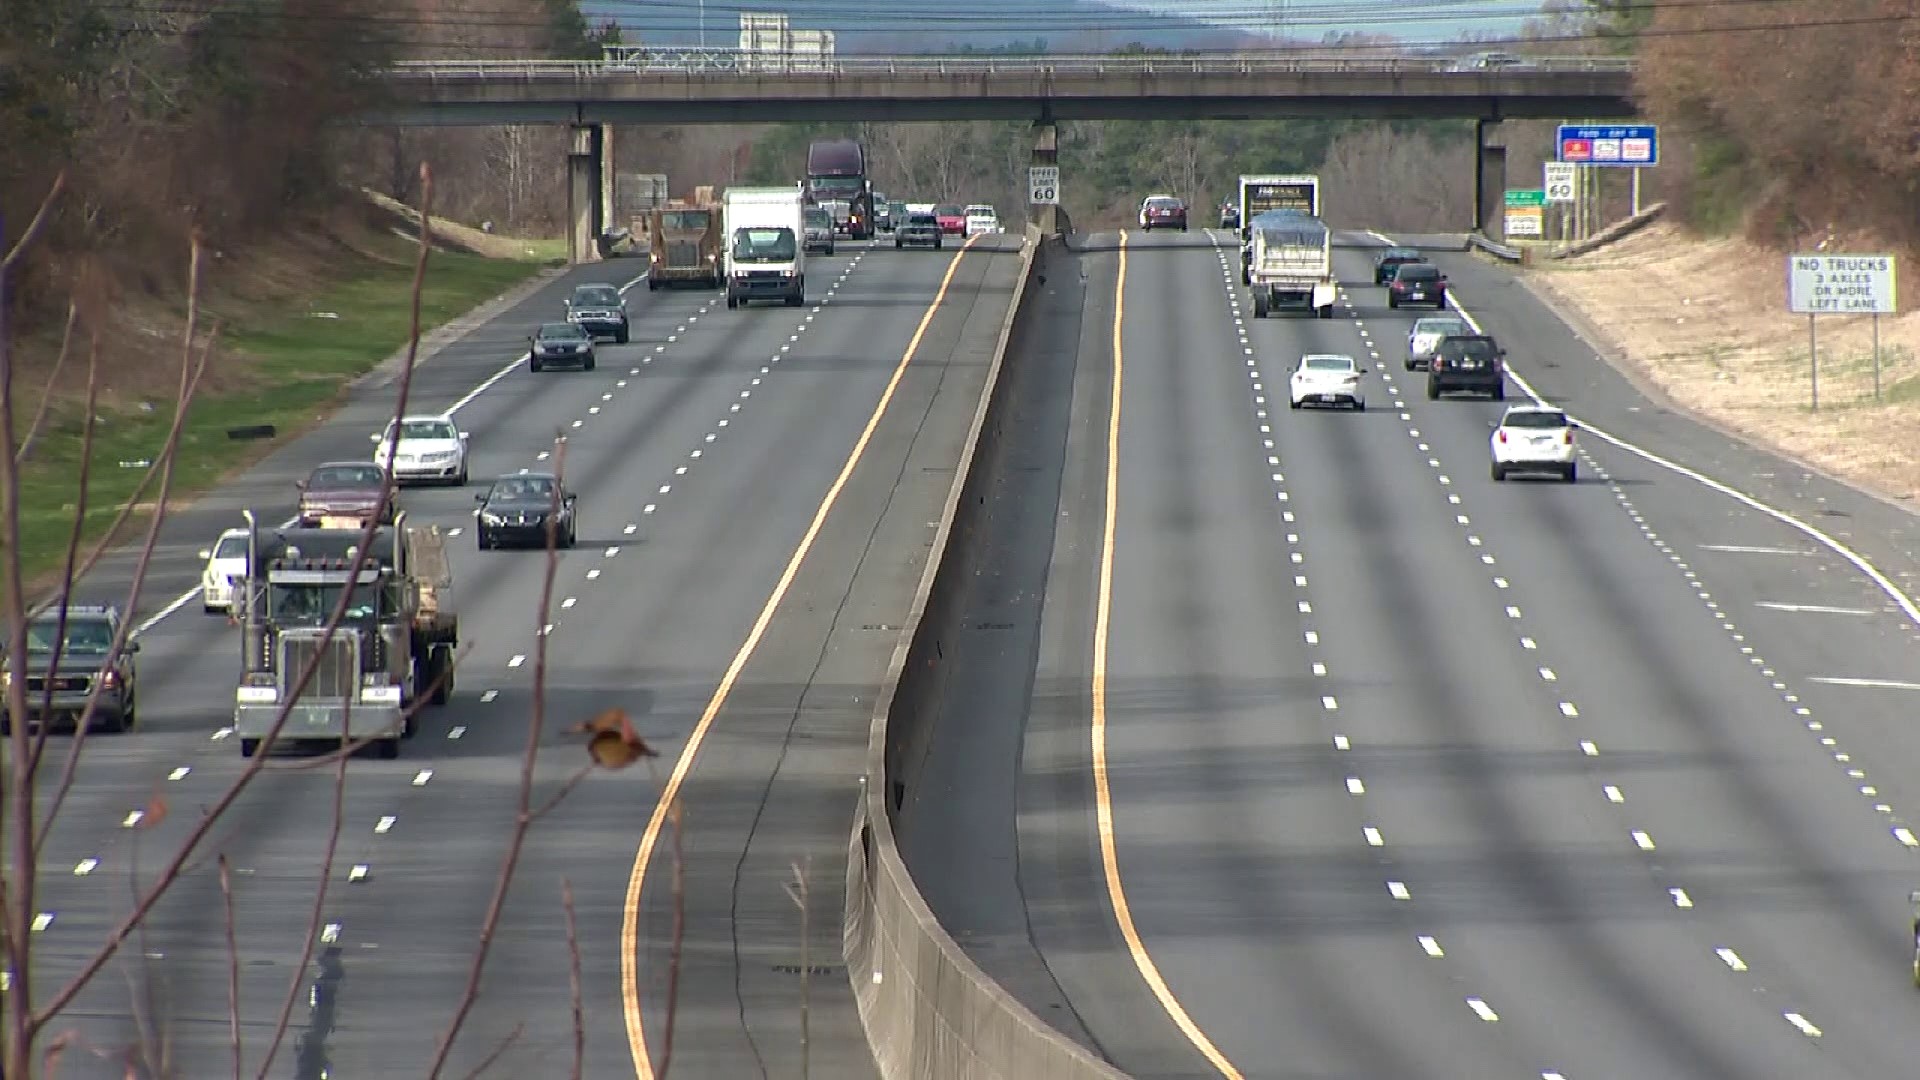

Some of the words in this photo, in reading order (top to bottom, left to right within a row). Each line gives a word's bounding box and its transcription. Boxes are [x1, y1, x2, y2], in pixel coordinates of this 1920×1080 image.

[1034, 187, 1054, 200] 60
[1549, 185, 1571, 198] 60
[1797, 258, 1819, 270] NO
[1828, 258, 1888, 270] TRUCKS
[1815, 274, 1824, 283] 3
[1830, 273, 1872, 283] AXLES
[1815, 286, 1831, 296] OR
[1839, 286, 1872, 296] MORE
[1810, 299, 1838, 308] LEFT
[1846, 299, 1877, 308] LANE
